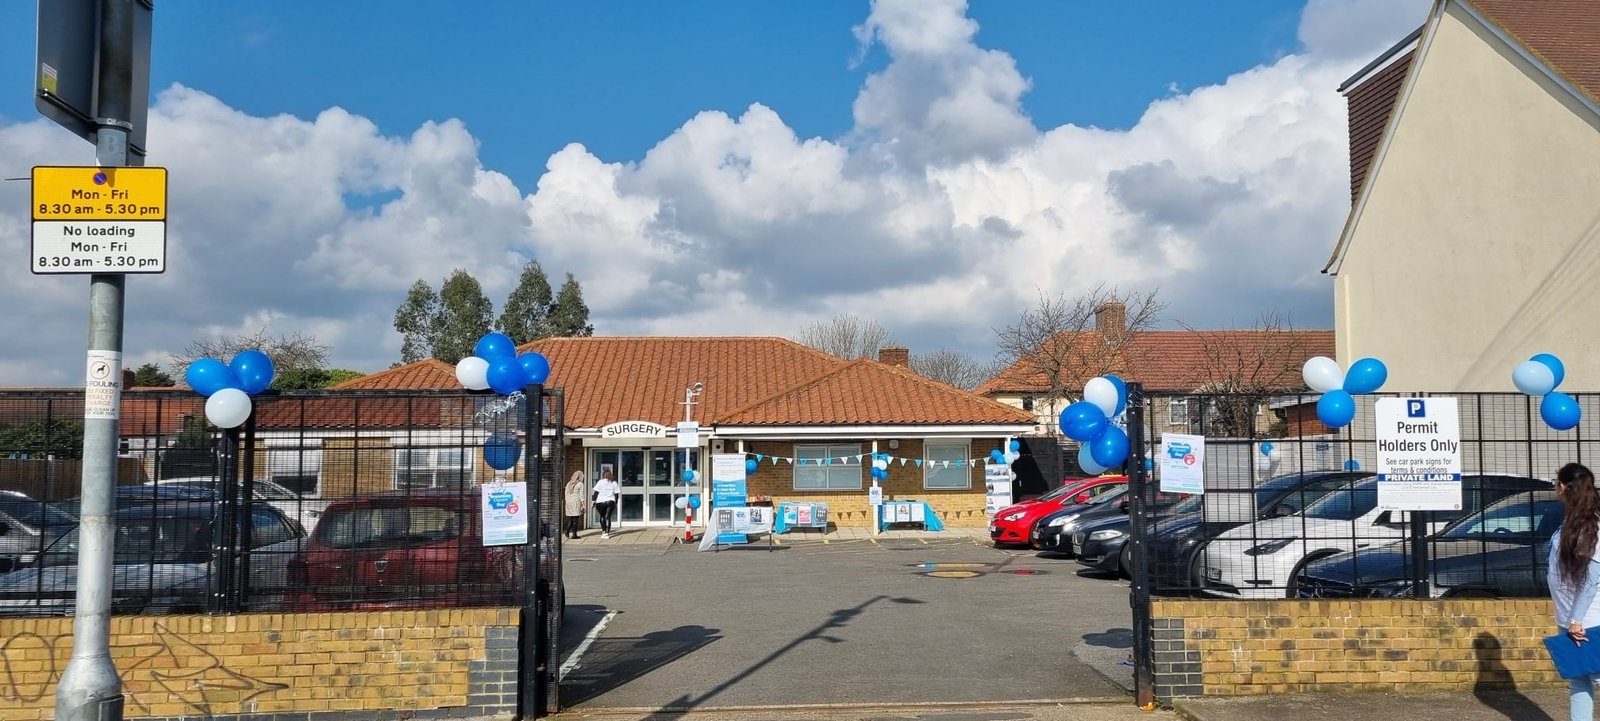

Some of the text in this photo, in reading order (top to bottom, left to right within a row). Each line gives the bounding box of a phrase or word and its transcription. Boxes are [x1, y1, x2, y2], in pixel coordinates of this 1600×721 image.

[71, 189, 99, 199] Mon
[111, 189, 128, 199] Fri
[39, 204, 71, 214] 8.30
[75, 205, 94, 214] am
[105, 204, 136, 214] 5.30
[140, 205, 160, 215] pm
[63, 226, 135, 237] No loading
[71, 242, 99, 252] Mon
[110, 242, 127, 252] Fri
[39, 256, 70, 267] 8.30
[74, 258, 93, 266] am
[104, 256, 135, 267] 5.30
[139, 258, 159, 268] pm
[1411, 403, 1421, 415] P
[606, 423, 661, 436] SURGERY
[1397, 421, 1439, 434] Permit
[1379, 438, 1458, 454] Holders Only
[1385, 457, 1397, 466] See
[1410, 457, 1424, 467] park
[1425, 457, 1442, 467] signs
[1443, 457, 1452, 465] for
[1390, 466, 1408, 474] terms
[1415, 466, 1448, 474] conditions
